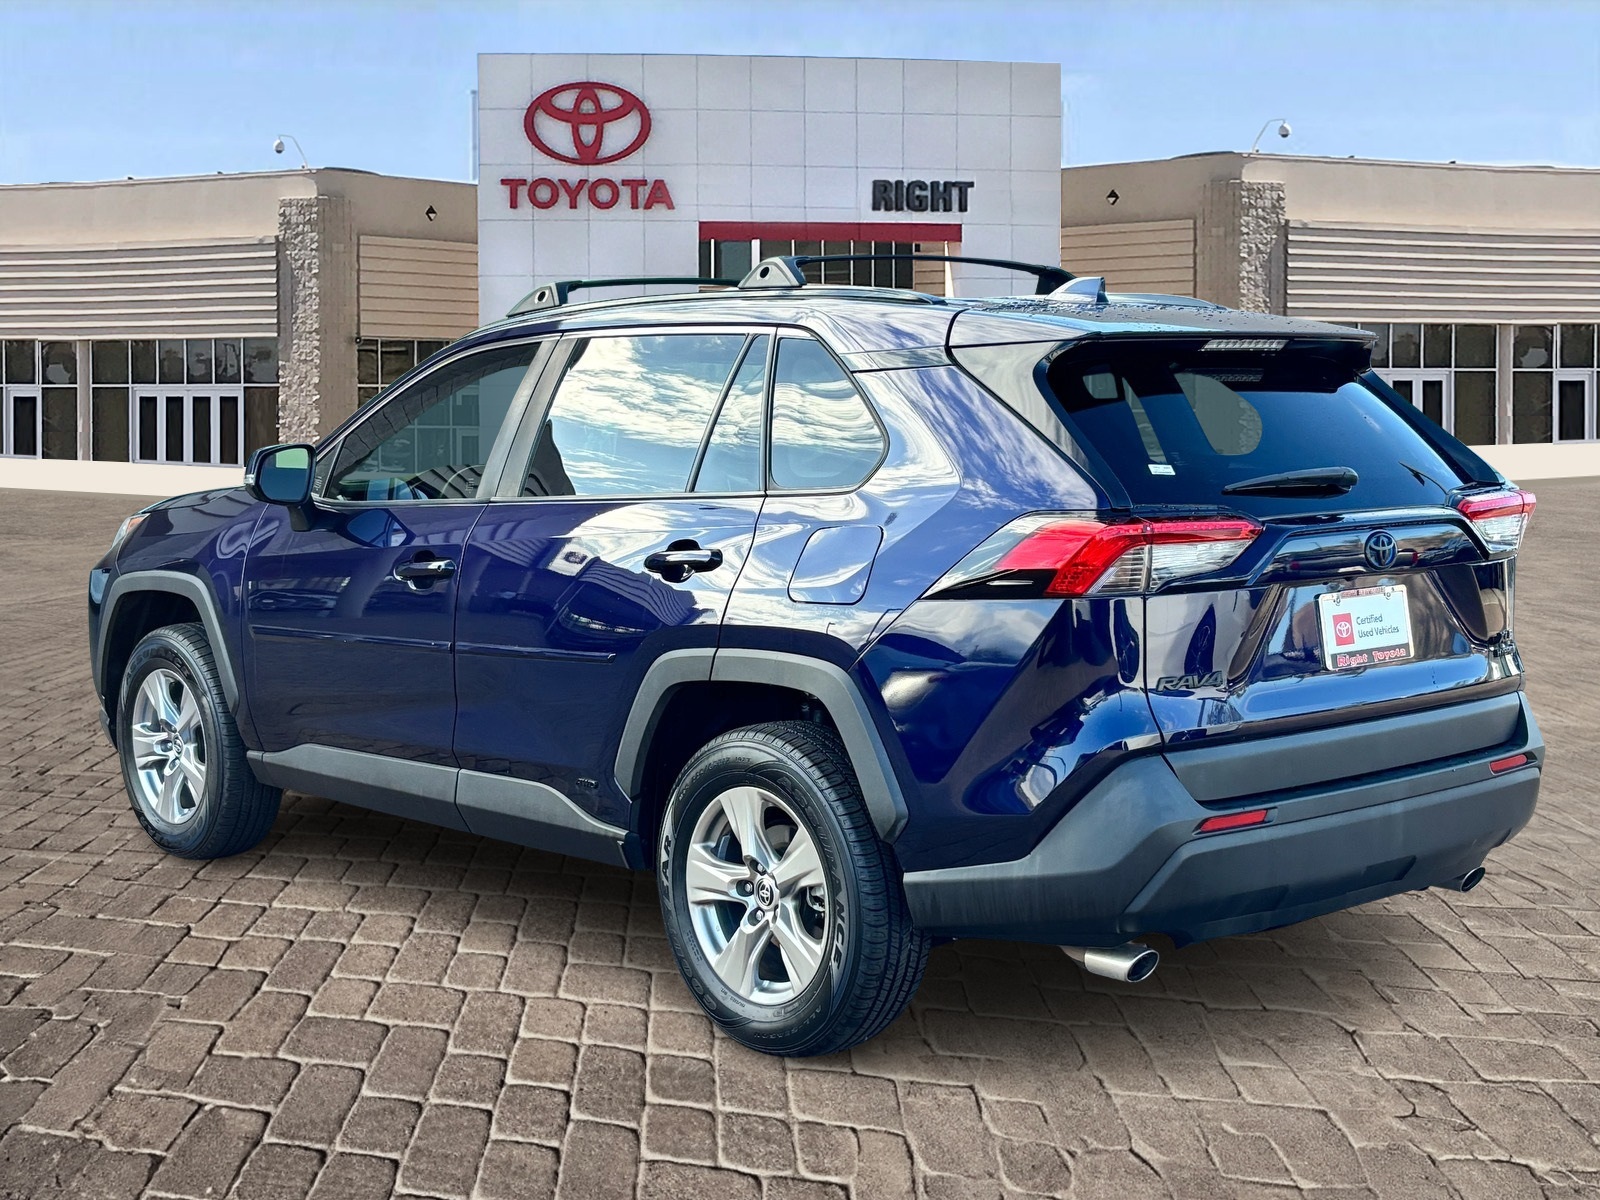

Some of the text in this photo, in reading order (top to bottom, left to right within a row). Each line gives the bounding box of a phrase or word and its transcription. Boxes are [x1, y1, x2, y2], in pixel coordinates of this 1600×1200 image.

[500, 178, 675, 210] TOYOTA
[872, 179, 975, 212] RIGHT
[1356, 613, 1383, 625] Certified
[1358, 625, 1400, 638] Used Vehicles
[1337, 648, 1406, 667] Right Toyota
[1156, 670, 1224, 692] RAV4
